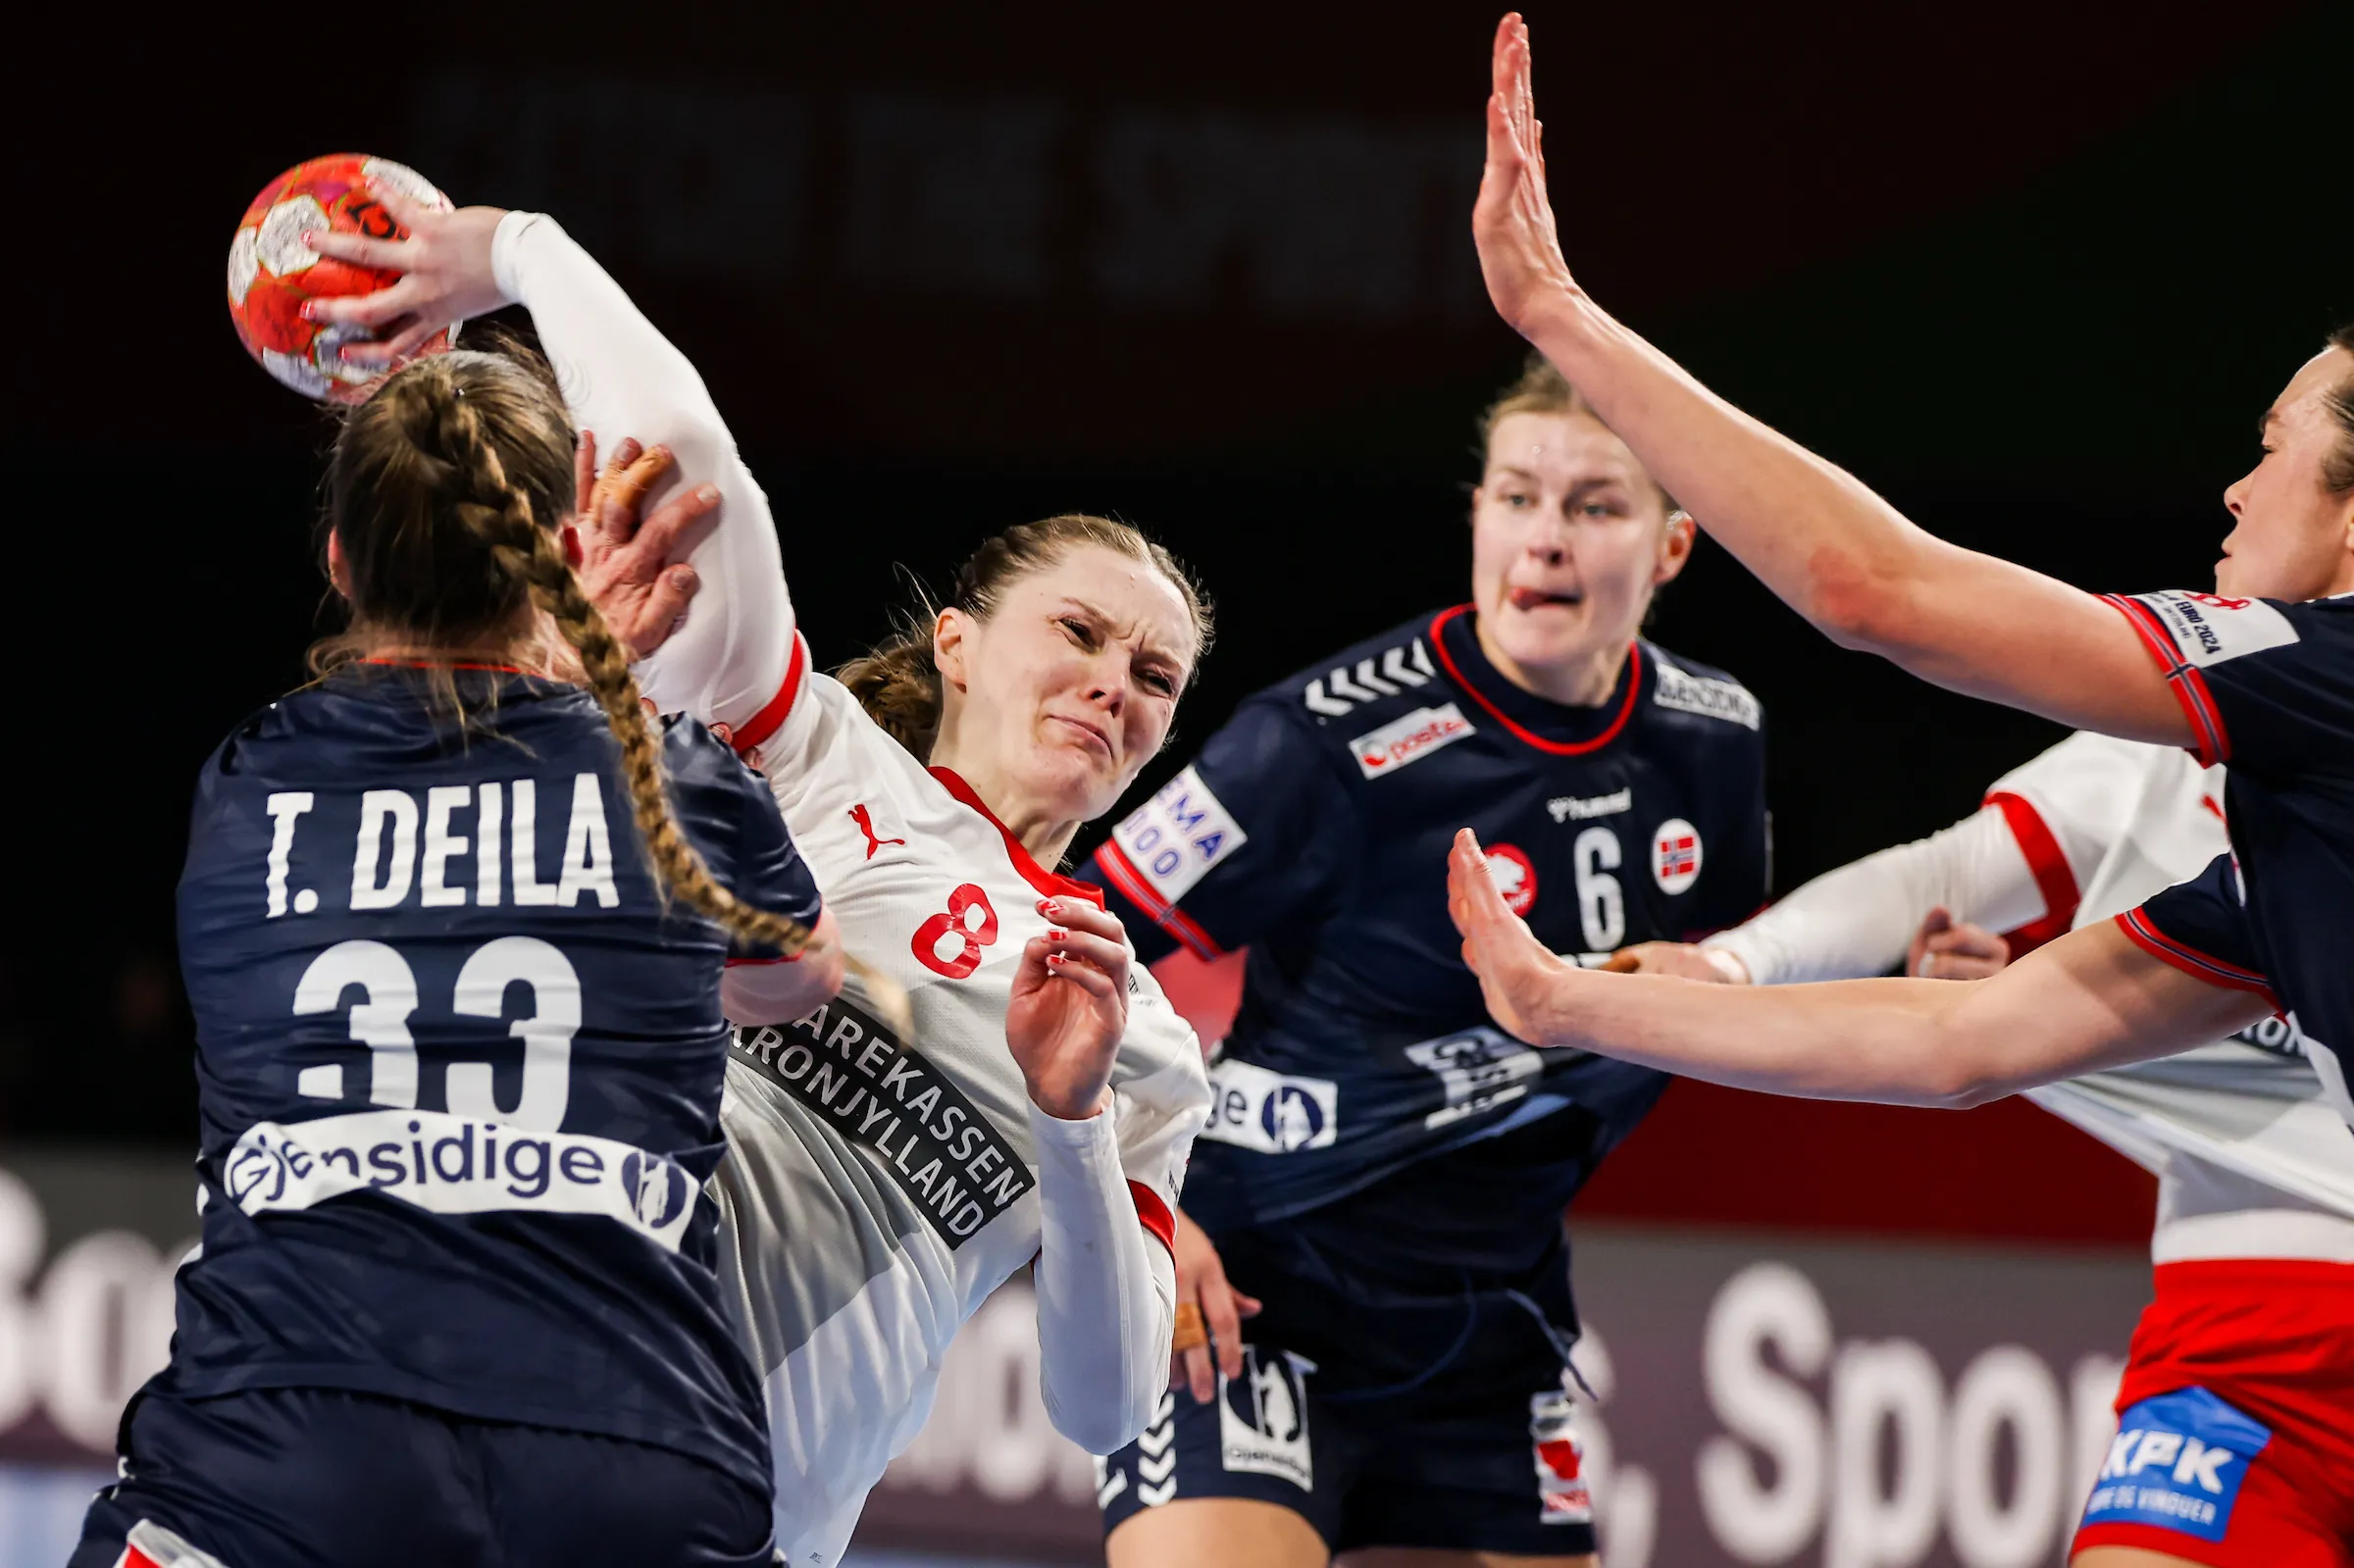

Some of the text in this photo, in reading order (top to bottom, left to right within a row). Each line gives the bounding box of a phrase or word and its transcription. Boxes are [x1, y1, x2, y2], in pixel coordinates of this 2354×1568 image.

[2193, 625, 2222, 655] 2024
[266, 773, 620, 918] T. DEILA
[1573, 827, 1626, 952] 6
[911, 883, 998, 979] 8
[292, 936, 582, 1134] 33
